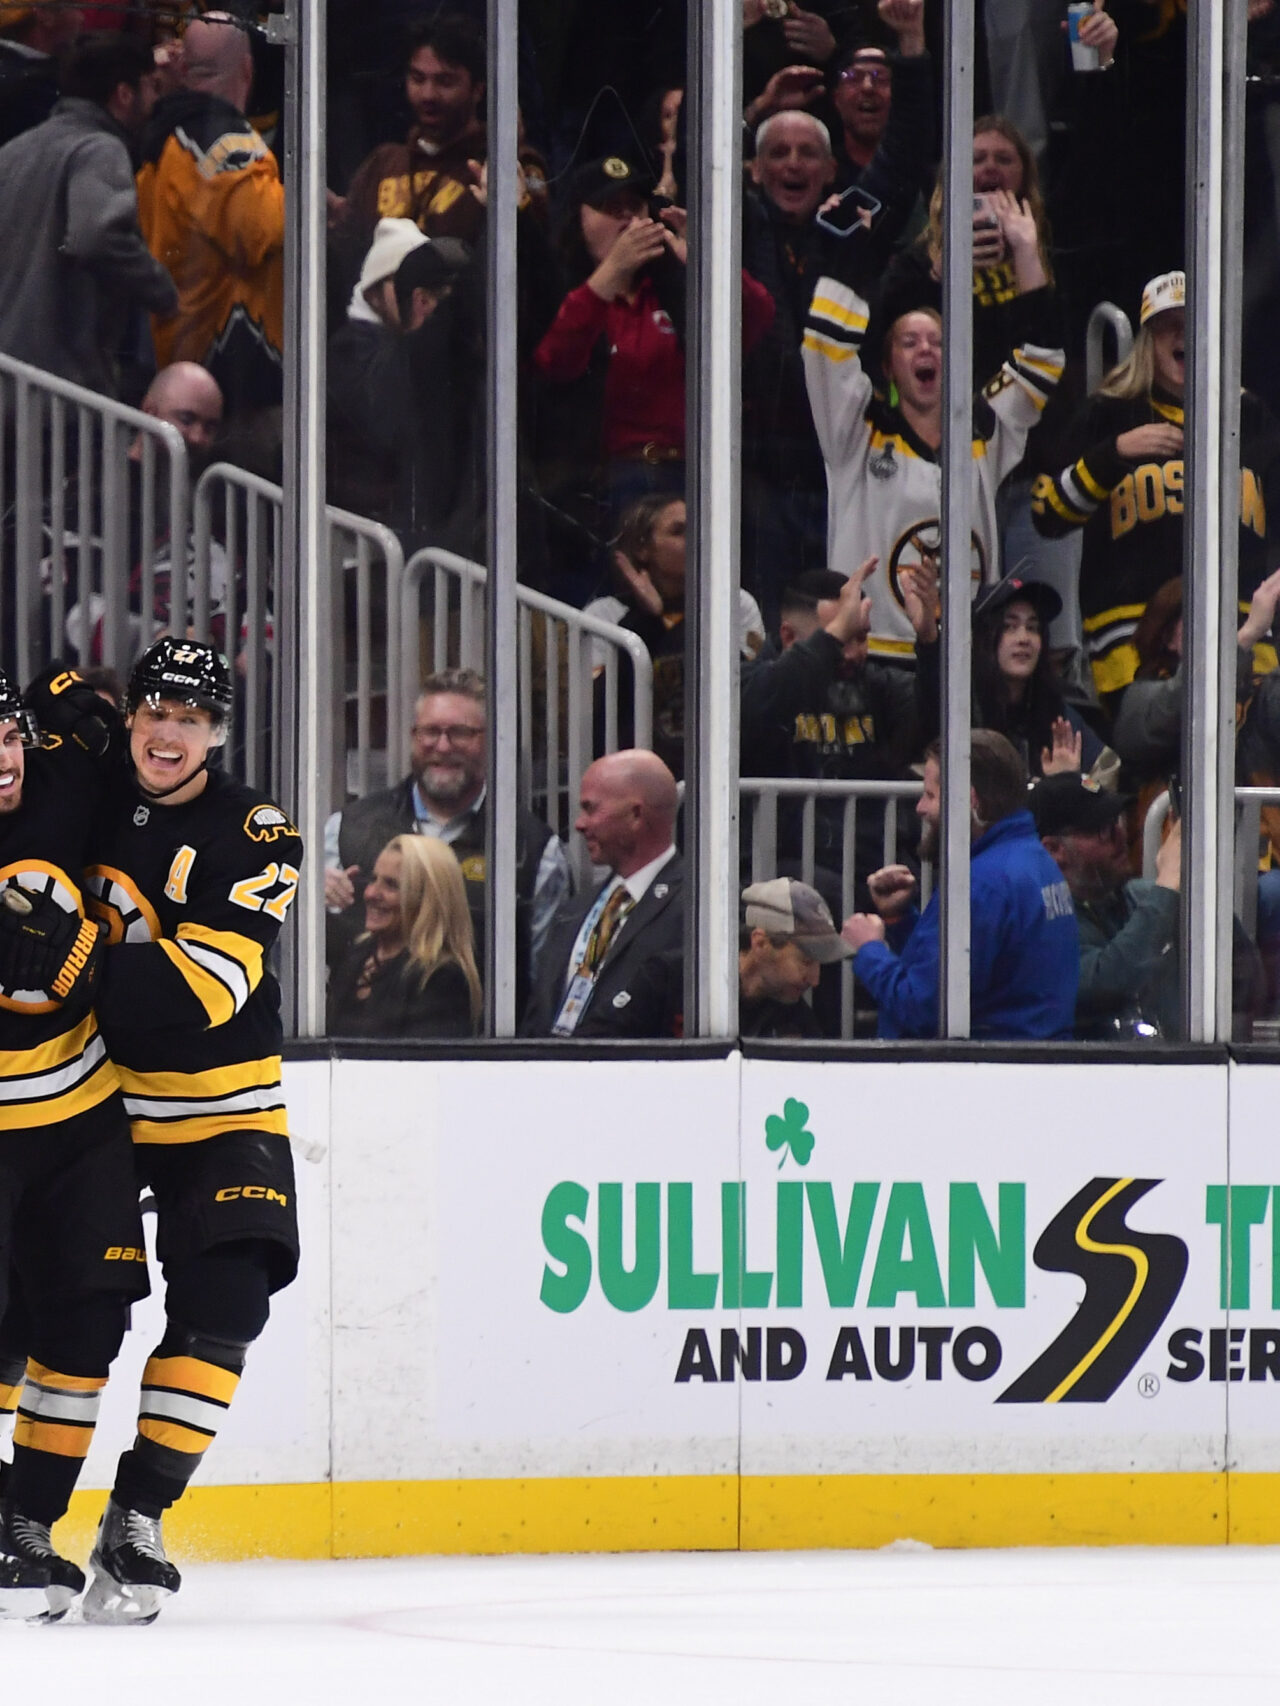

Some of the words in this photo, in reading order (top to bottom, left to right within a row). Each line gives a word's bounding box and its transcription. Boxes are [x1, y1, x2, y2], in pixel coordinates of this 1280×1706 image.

[1111, 460, 1266, 540] BOSN
[161, 672, 201, 687] CCM
[164, 844, 197, 904] A
[228, 862, 300, 923] 27
[214, 1185, 287, 1208] CCM
[540, 1181, 1027, 1314] SULLIVAN
[674, 1327, 807, 1383] AND
[825, 1325, 1003, 1383] AUTO
[1166, 1327, 1280, 1383] SER
